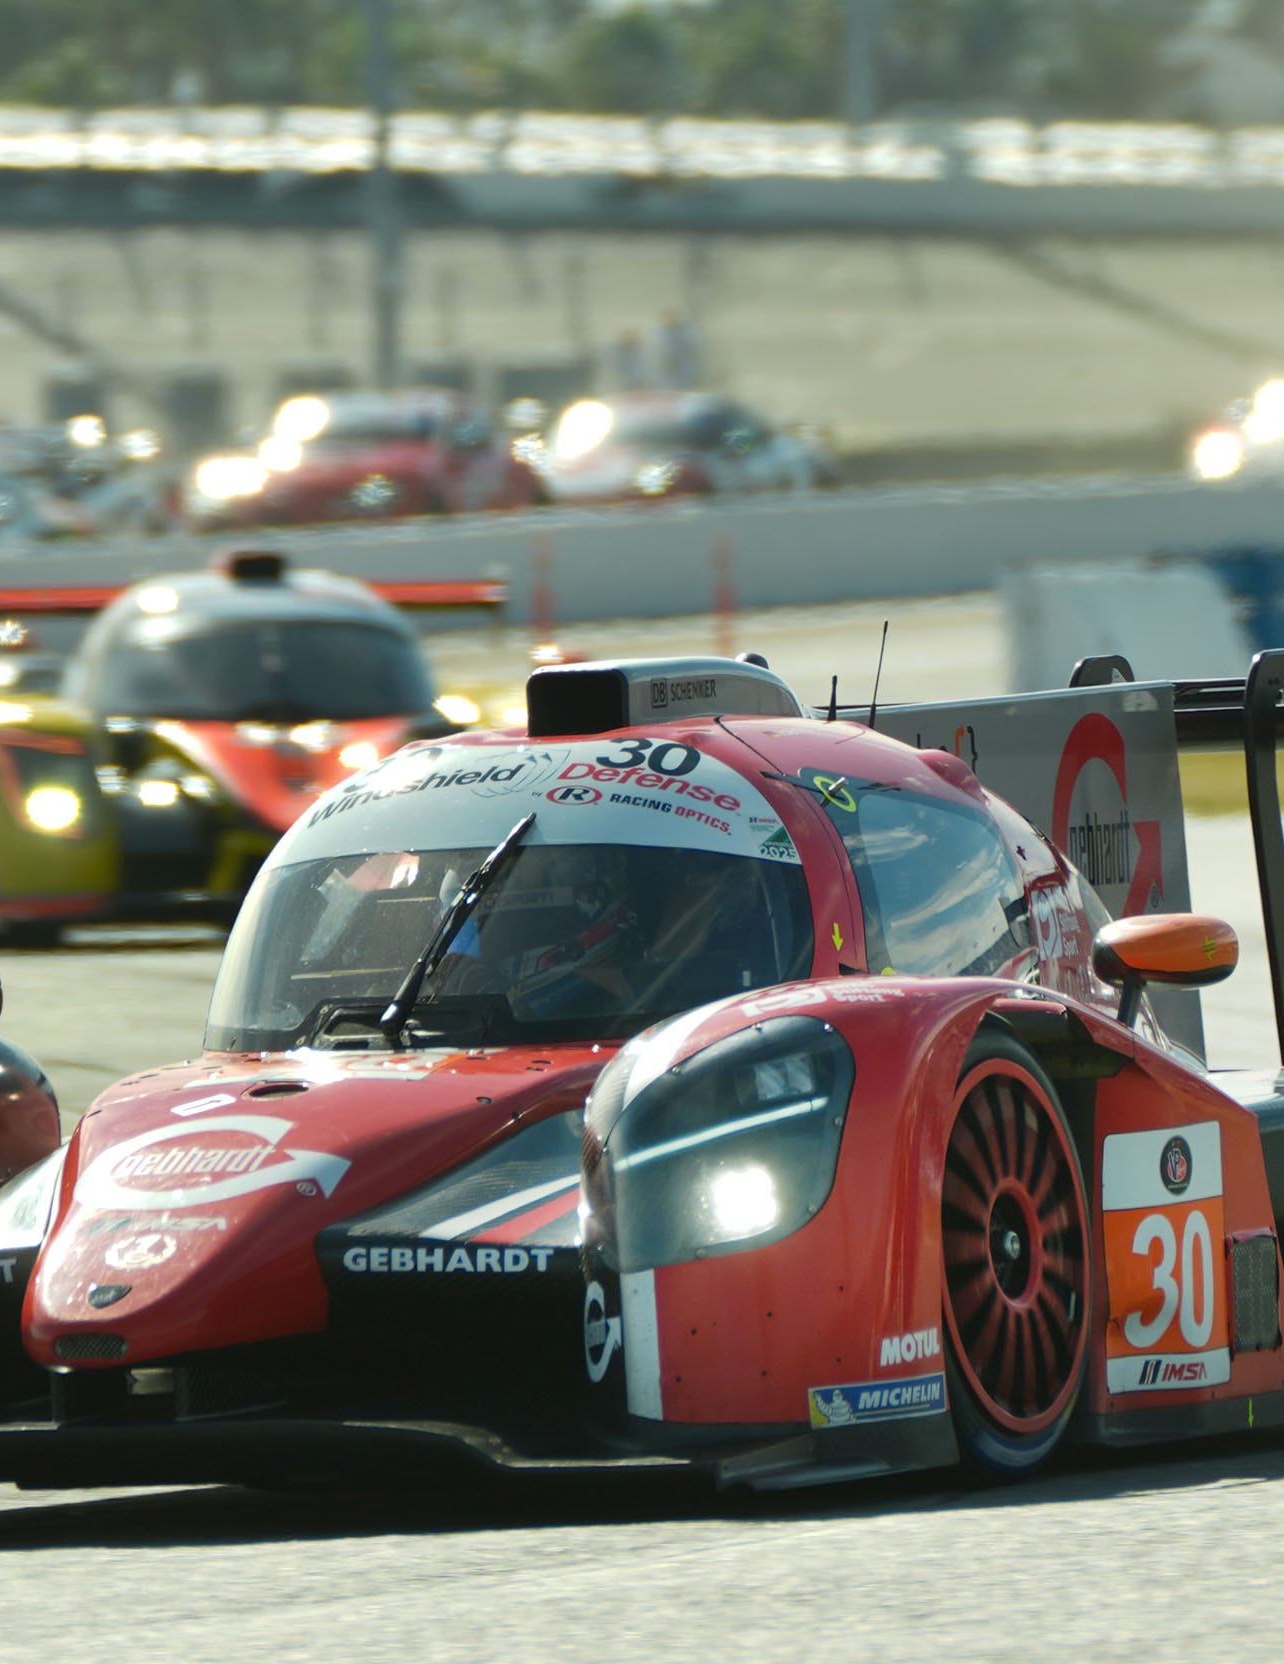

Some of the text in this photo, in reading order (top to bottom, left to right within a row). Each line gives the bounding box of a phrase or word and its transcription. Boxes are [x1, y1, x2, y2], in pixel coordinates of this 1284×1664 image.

[651, 679, 716, 706] DB SCHENKER
[595, 738, 701, 777] 30
[557, 763, 741, 812] Defense
[609, 793, 672, 813] RACING
[343, 1247, 554, 1273] GEBHARDT
[1124, 1210, 1214, 1348] 30
[880, 1328, 941, 1367] MOTUL
[1161, 1362, 1208, 1381] IMSA
[859, 1382, 941, 1410] MICHELIN
